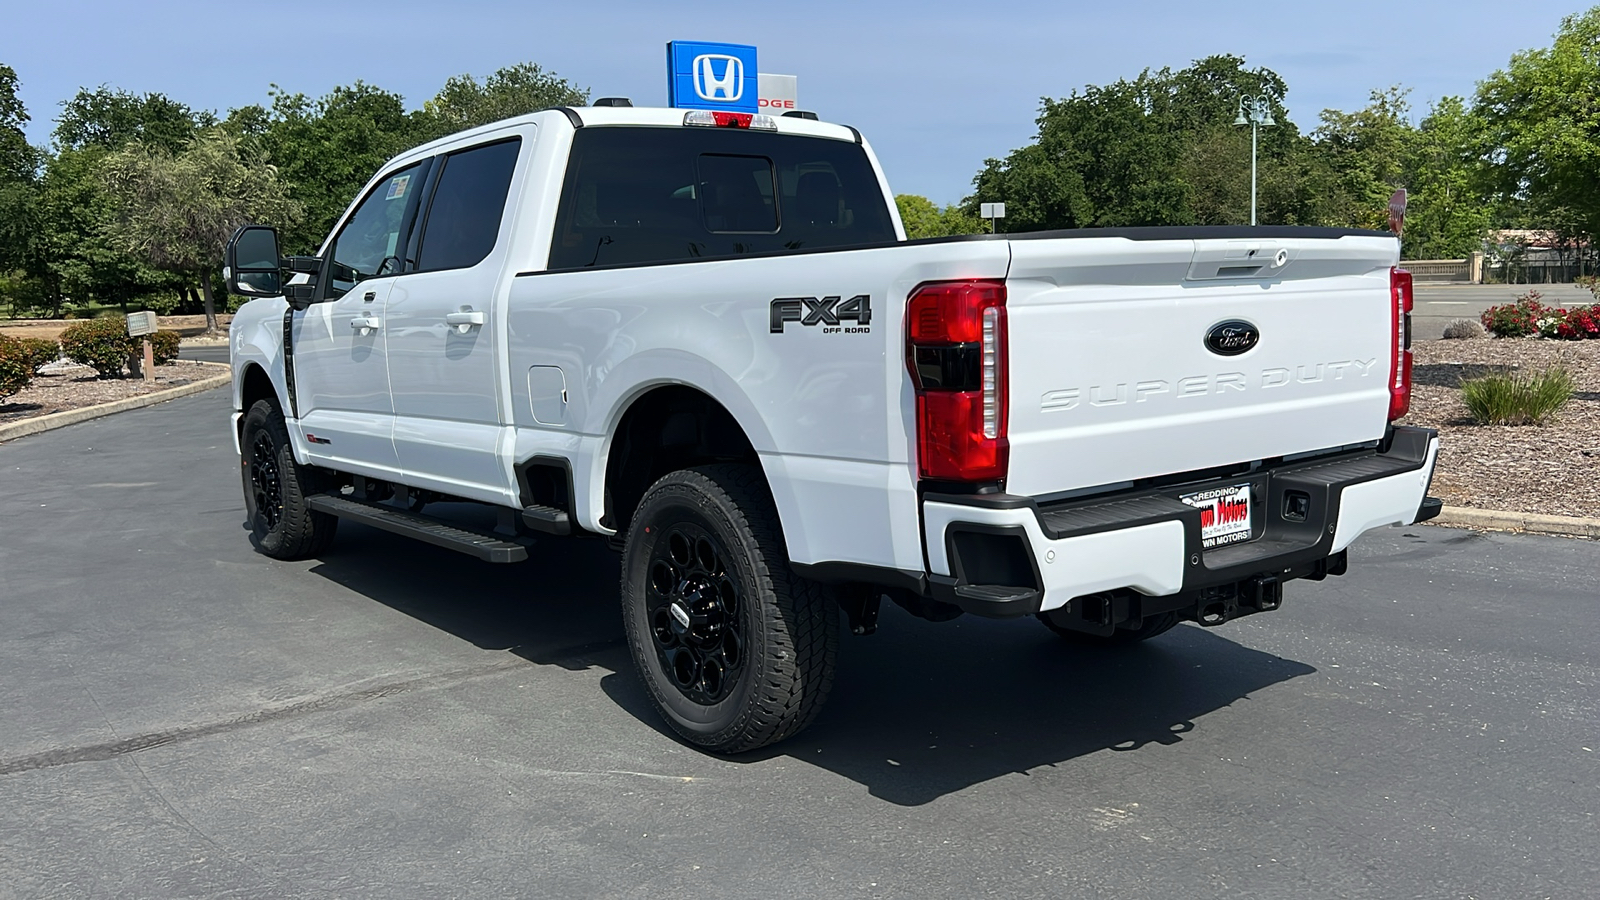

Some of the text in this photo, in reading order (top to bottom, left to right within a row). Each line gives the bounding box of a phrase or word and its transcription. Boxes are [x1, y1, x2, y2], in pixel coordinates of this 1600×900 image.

[758, 98, 795, 109] DGE
[770, 295, 872, 334] FX4
[1220, 327, 1251, 348] Ford
[1040, 357, 1377, 413] SUPER DUTY
[1198, 487, 1235, 501] REDDING
[1217, 496, 1248, 526] Motors
[1216, 531, 1248, 545] MOTORS
